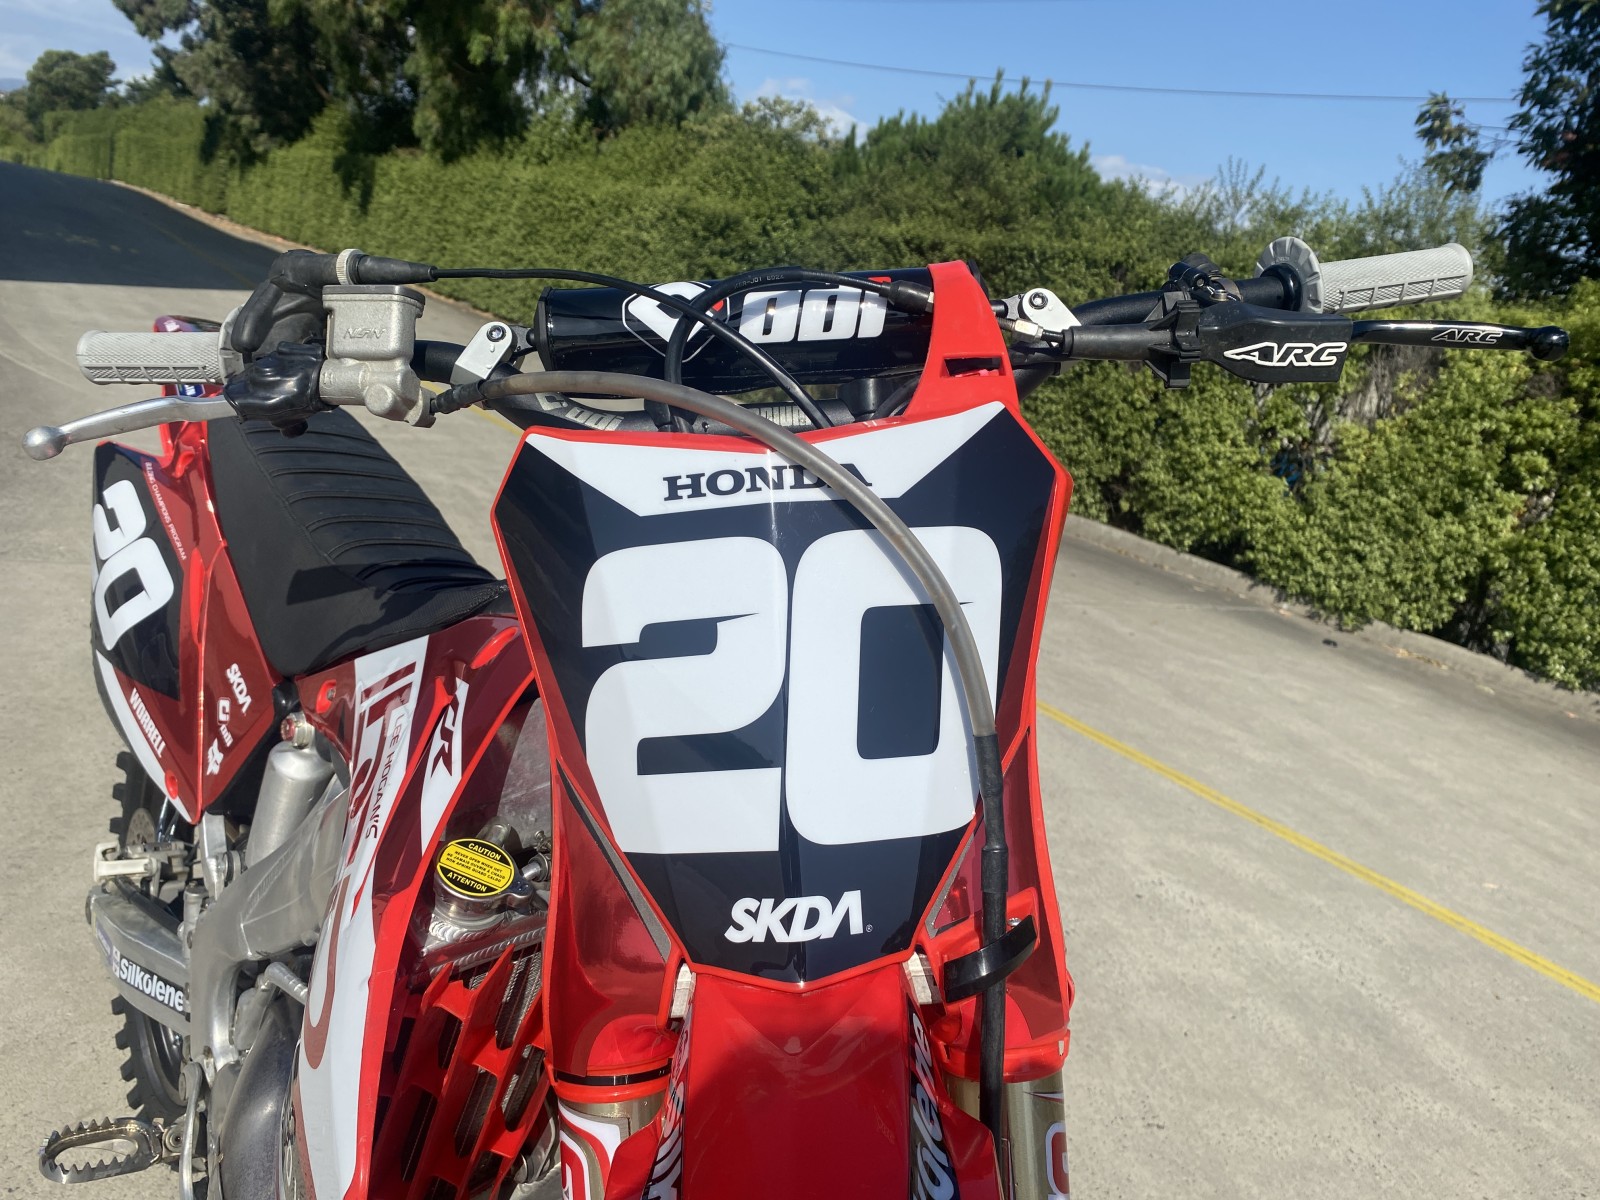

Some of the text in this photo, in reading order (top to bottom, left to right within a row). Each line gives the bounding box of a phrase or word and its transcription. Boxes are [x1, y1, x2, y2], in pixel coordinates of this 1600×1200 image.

[1223, 342, 1347, 366] ARC
[1431, 329, 1503, 344] ARC
[151, 484, 170, 525] CHAMPIONS
[166, 524, 187, 560] PROGRAM
[91, 479, 174, 651] 20
[226, 663, 252, 713] SKDA
[582, 525, 1003, 854] 20
[130, 688, 166, 758] WORRELL
[364, 713, 405, 839] LEE HOGAN'S
[468, 843, 501, 860] CAUTION
[481, 862, 494, 870] WHEN
[447, 872, 487, 892] ATTENTION
[723, 890, 864, 943] SKDA
[120, 958, 185, 1012] Silkolene
